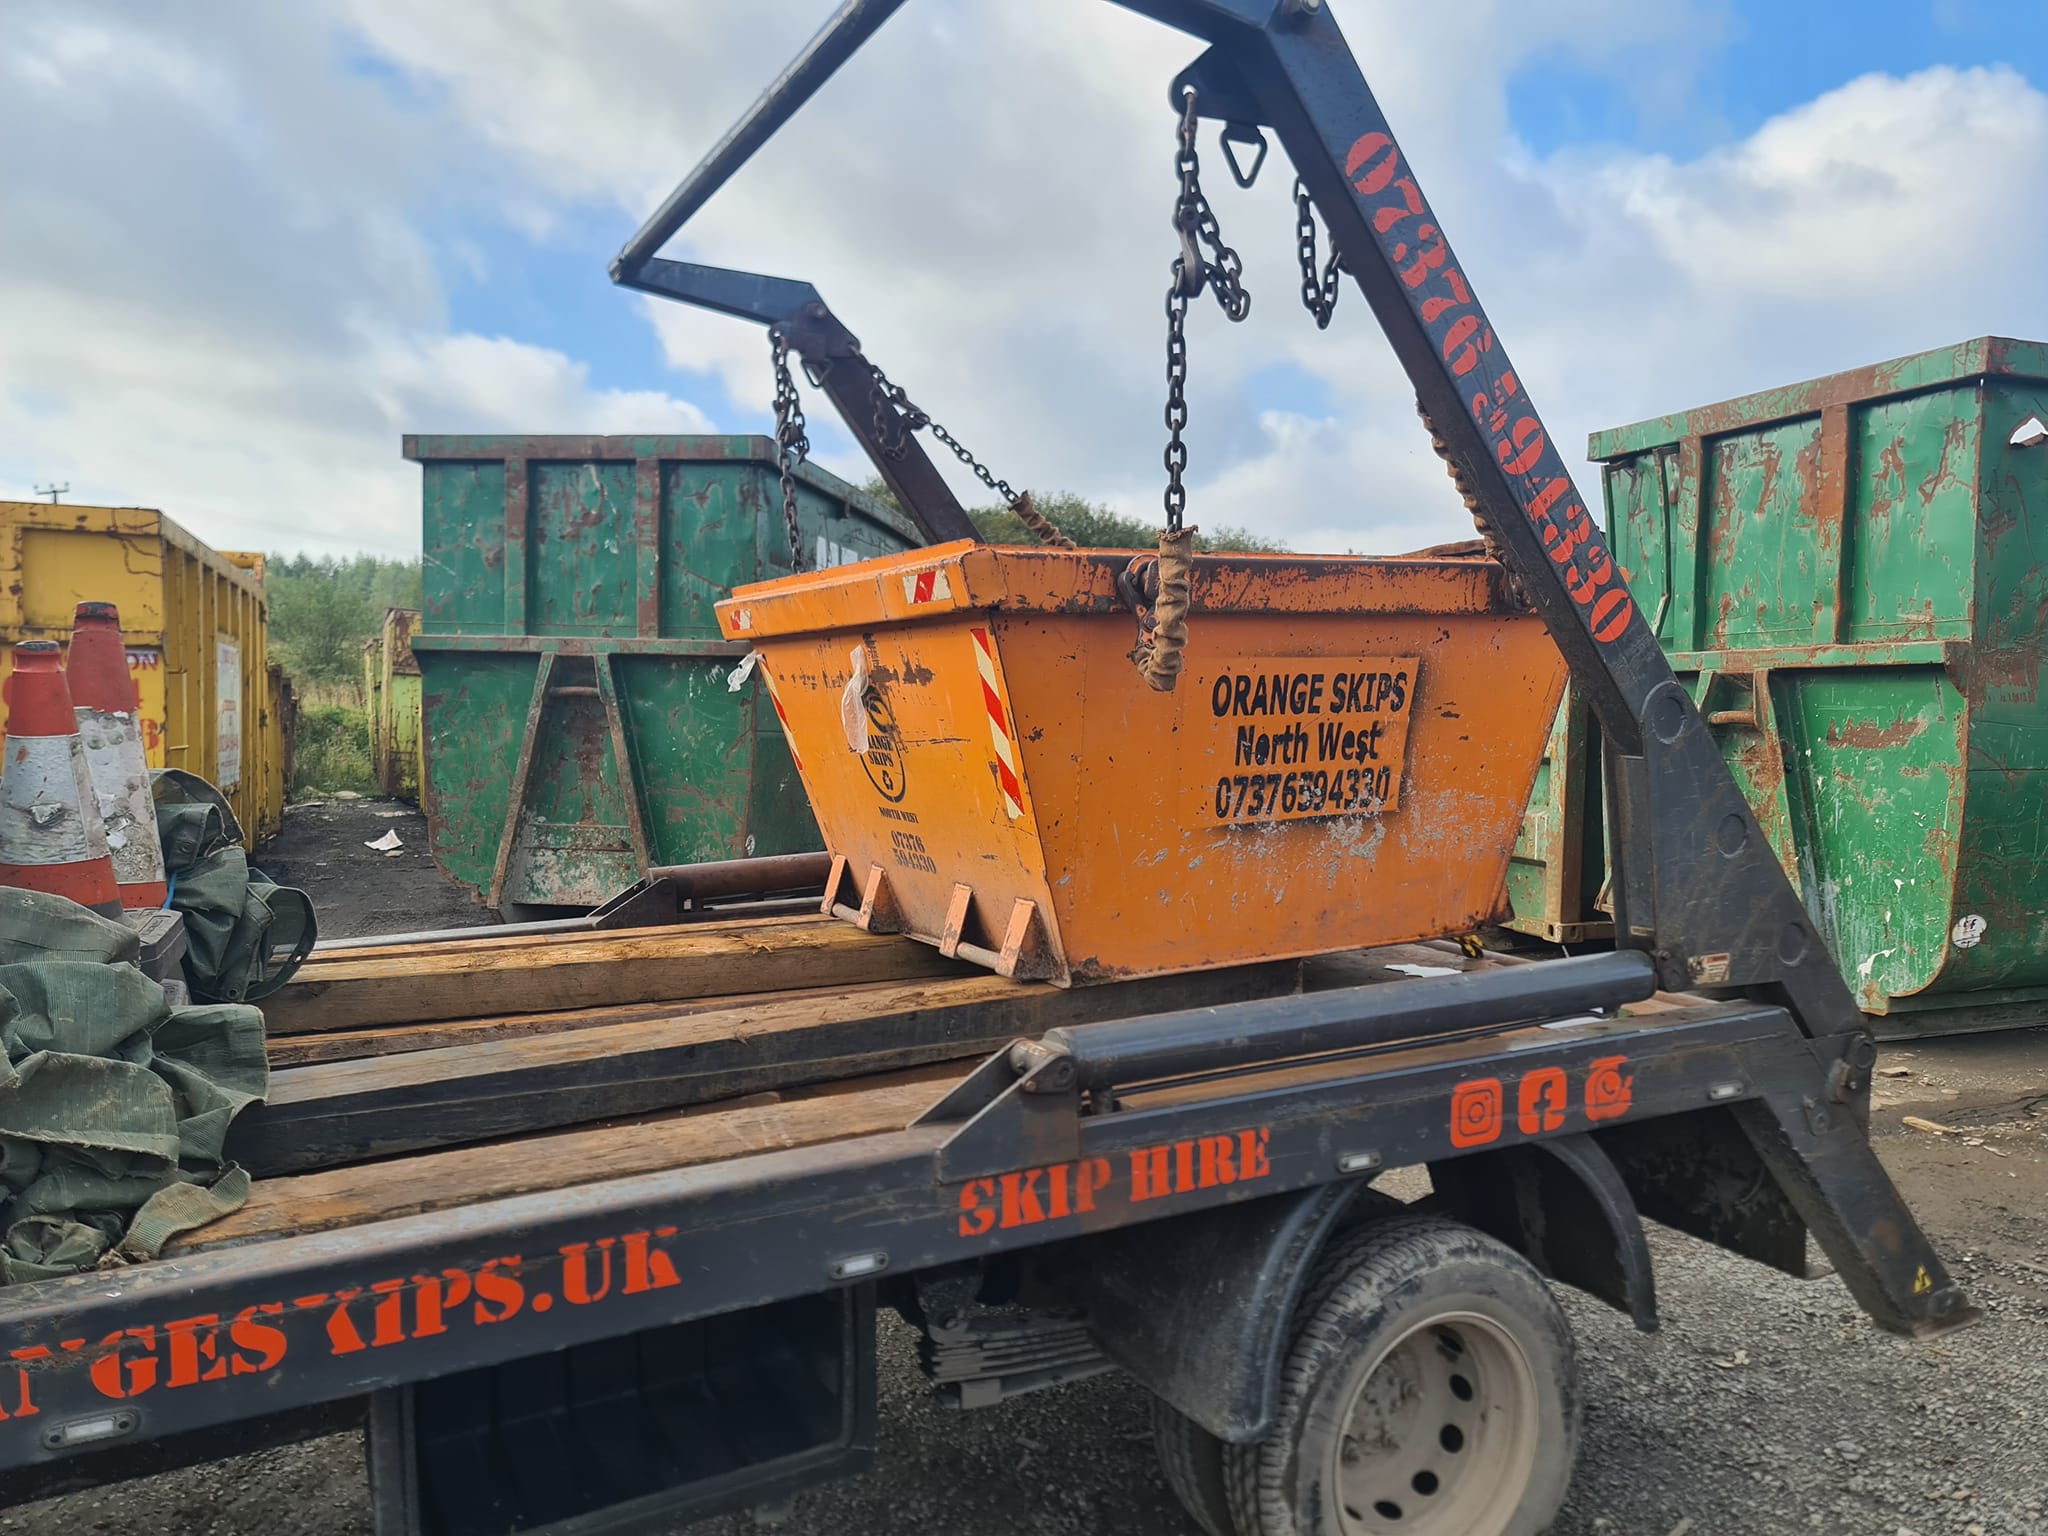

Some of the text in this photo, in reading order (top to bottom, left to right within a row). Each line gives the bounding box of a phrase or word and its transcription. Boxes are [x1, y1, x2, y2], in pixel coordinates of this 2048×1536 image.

[1211, 672, 1408, 717] ORANGE SKIPS
[868, 735, 893, 751] ANGE
[868, 751, 894, 767] SKIPS
[1235, 720, 1385, 766] North West
[1215, 766, 1391, 819] 07376594330
[891, 830, 925, 854] 07376
[959, 1127, 1271, 1237] SKIP HIRE
